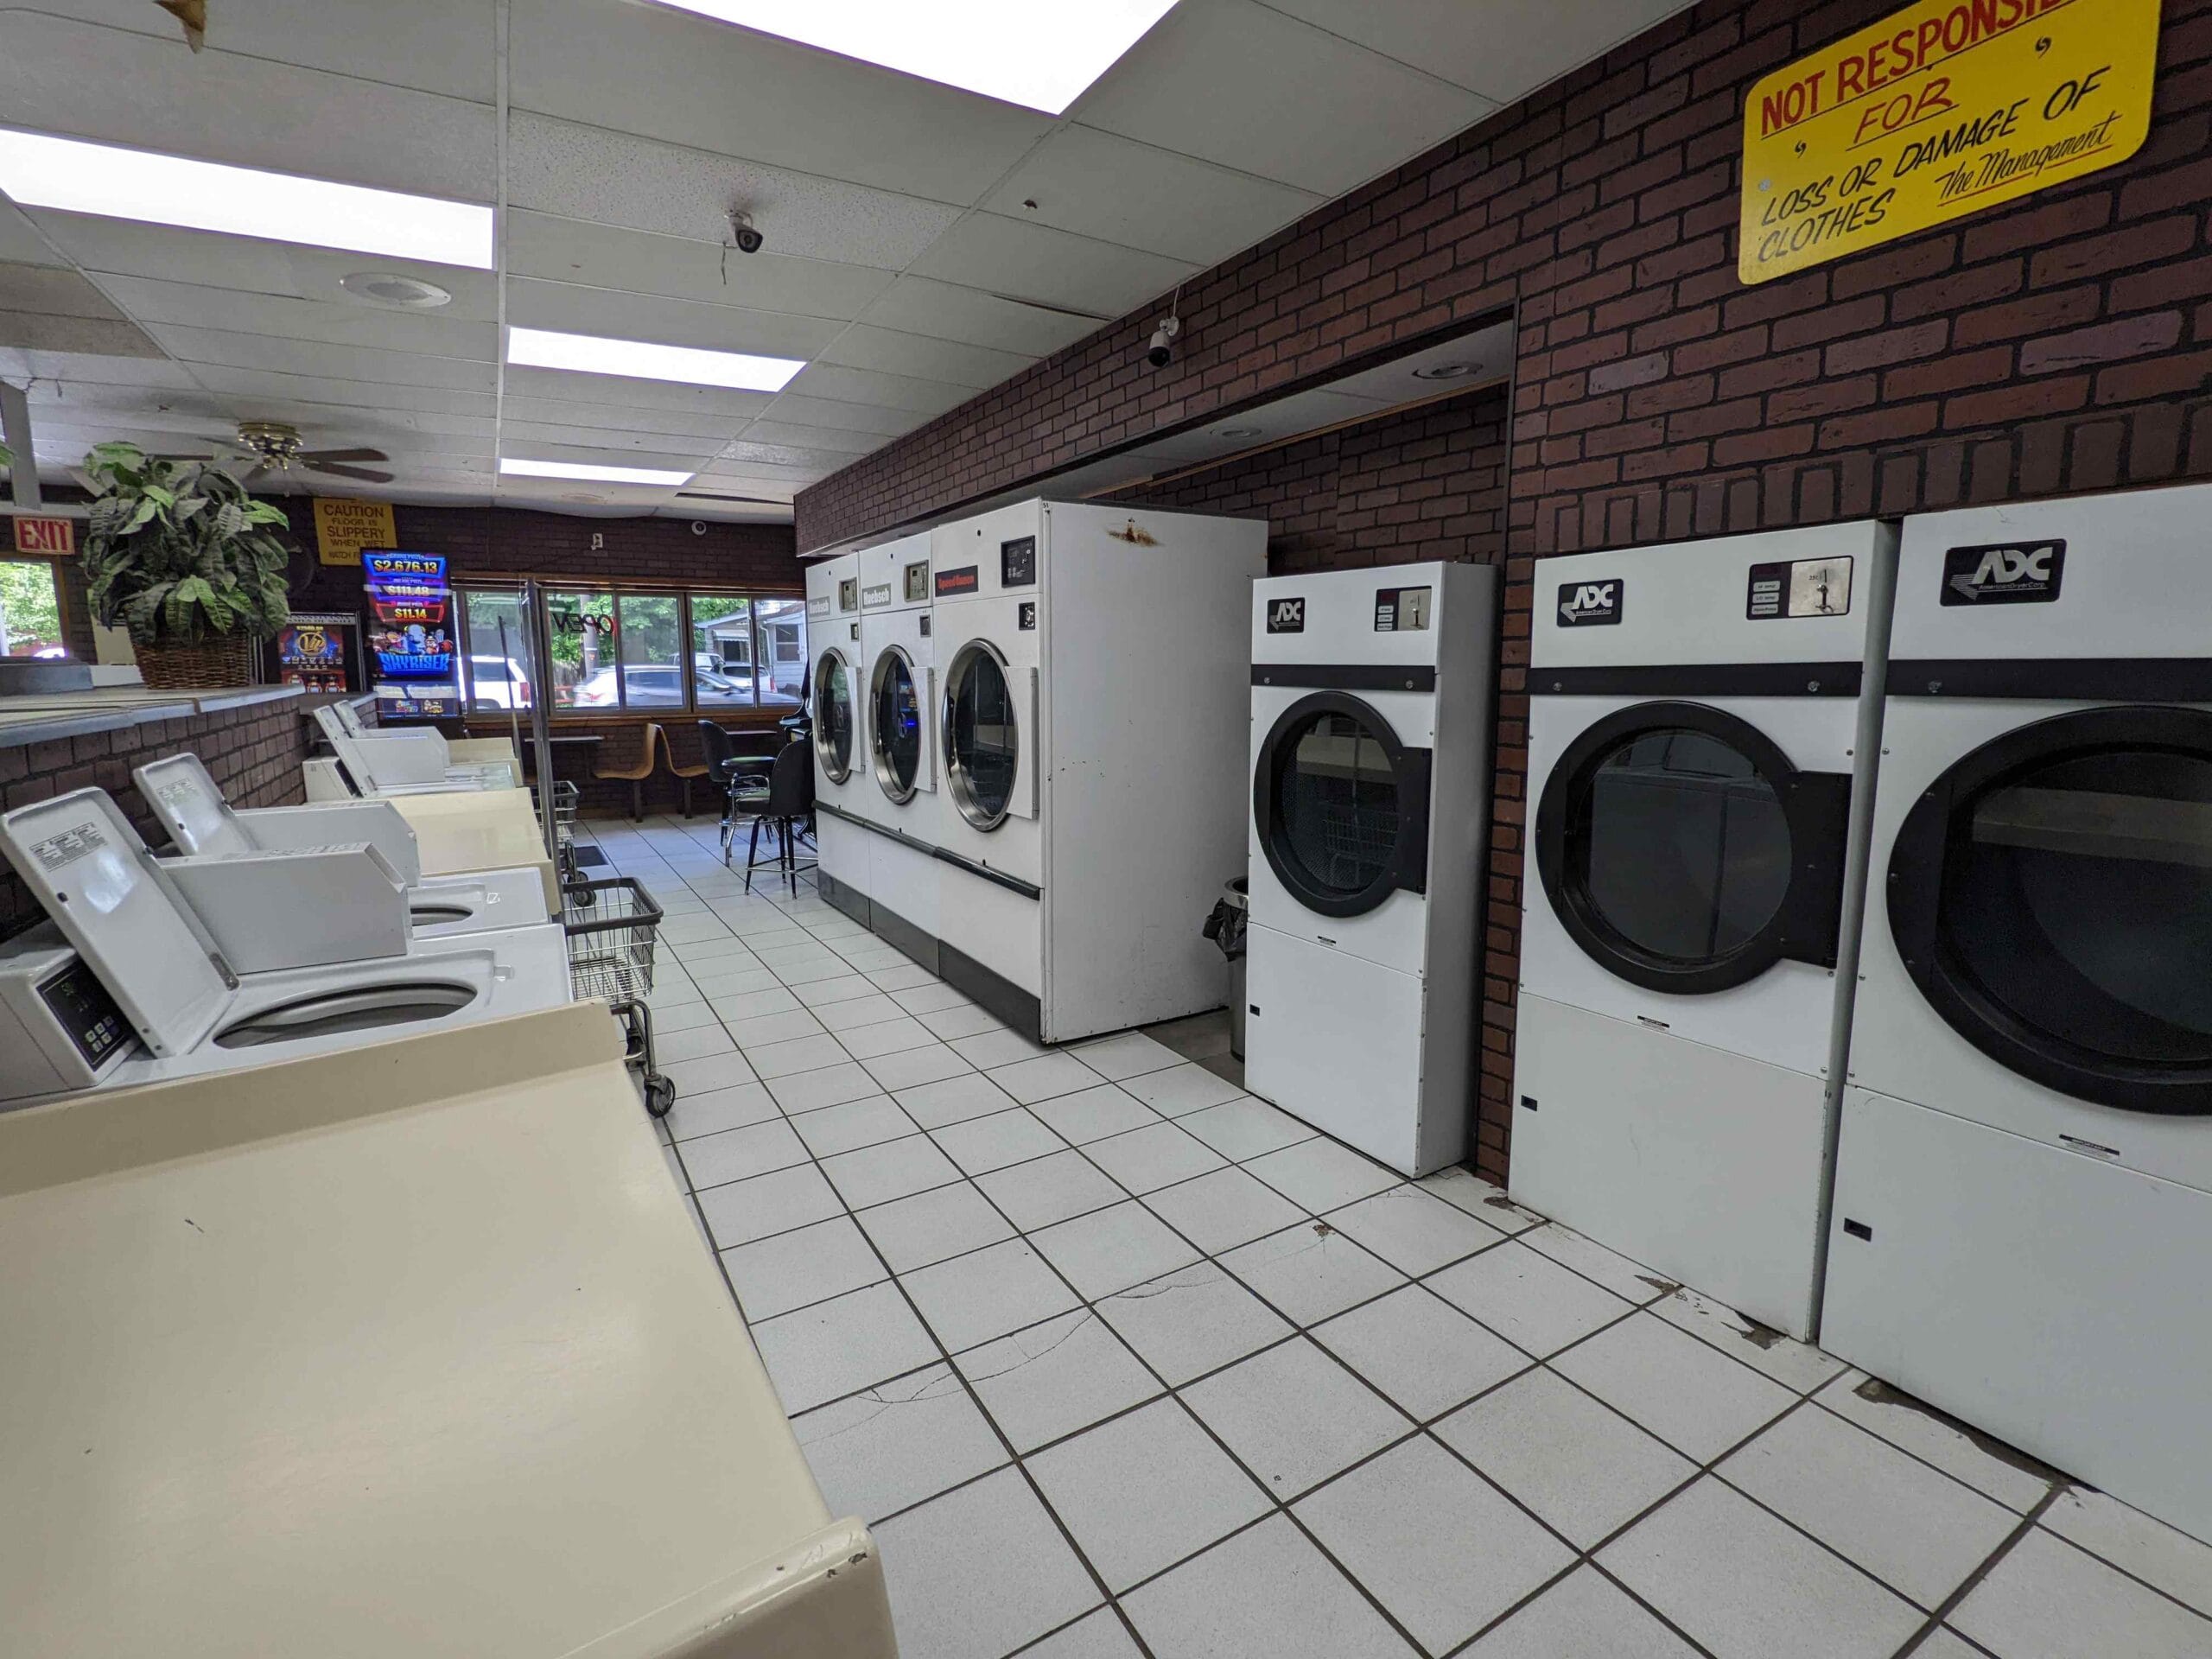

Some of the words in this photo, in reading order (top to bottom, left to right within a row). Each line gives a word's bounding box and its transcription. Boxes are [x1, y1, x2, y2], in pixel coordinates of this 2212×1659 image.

[1761, 70, 1826, 136] NOT
[1838, 0, 2062, 103] RESPONS
[1853, 77, 1953, 144] FOR
[1761, 175, 1834, 226] LOSS
[1839, 157, 1883, 197] OR
[1893, 98, 2030, 178] DAMAGE
[2044, 65, 2112, 120] OF
[1934, 161, 1974, 200] The
[1974, 111, 2123, 188] Management
[1758, 188, 1896, 262] CLOTHES
[324, 505, 384, 518] CAUTION
[332, 518, 363, 526] FLOOR
[18, 520, 68, 551] EXIT
[327, 526, 385, 538] SLIPPERY
[330, 538, 360, 547] WHEN
[1971, 546, 2054, 585] ADC
[1571, 583, 1614, 610] ADC
[394, 608, 427, 619] $11.14
[1275, 601, 1301, 622] ADC
